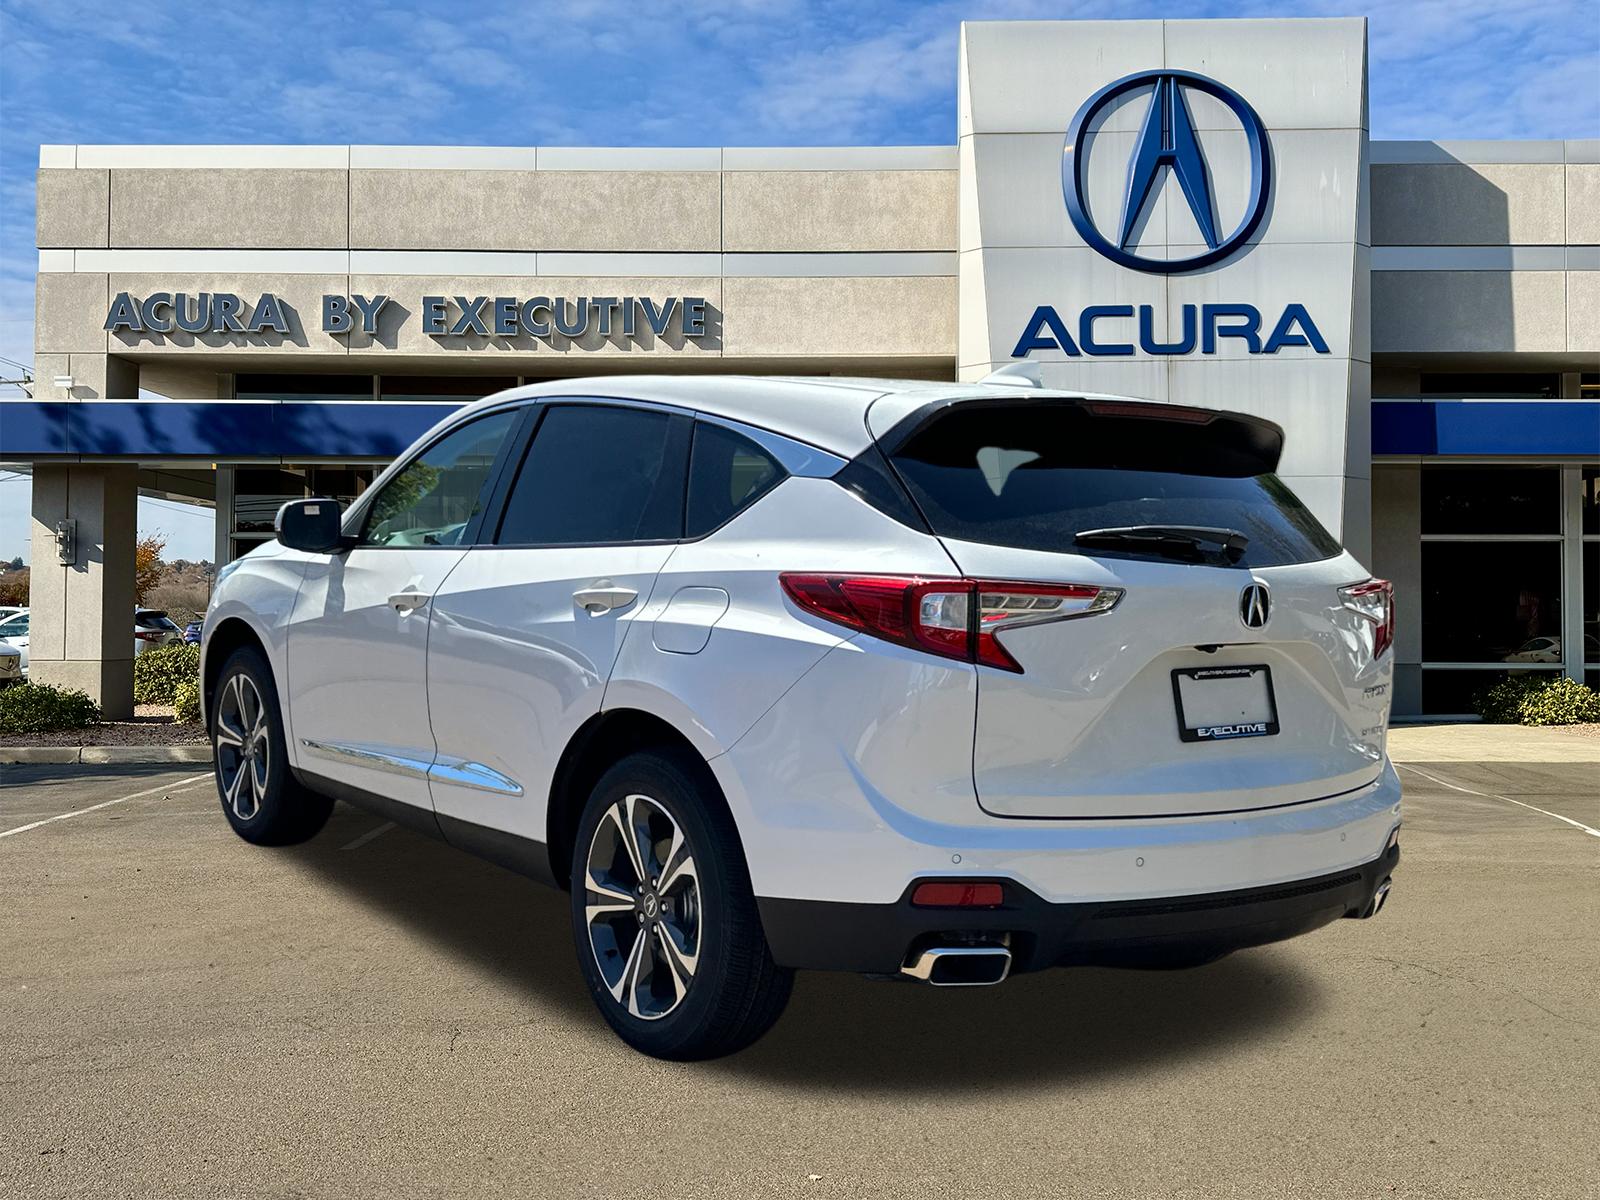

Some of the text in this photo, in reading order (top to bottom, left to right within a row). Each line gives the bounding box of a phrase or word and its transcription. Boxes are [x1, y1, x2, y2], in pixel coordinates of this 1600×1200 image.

[104, 291, 707, 338] ACURA BY EXECUTIVE
[1011, 303, 1332, 357] ACURA
[1197, 723, 1267, 737] EXECUTIVE
